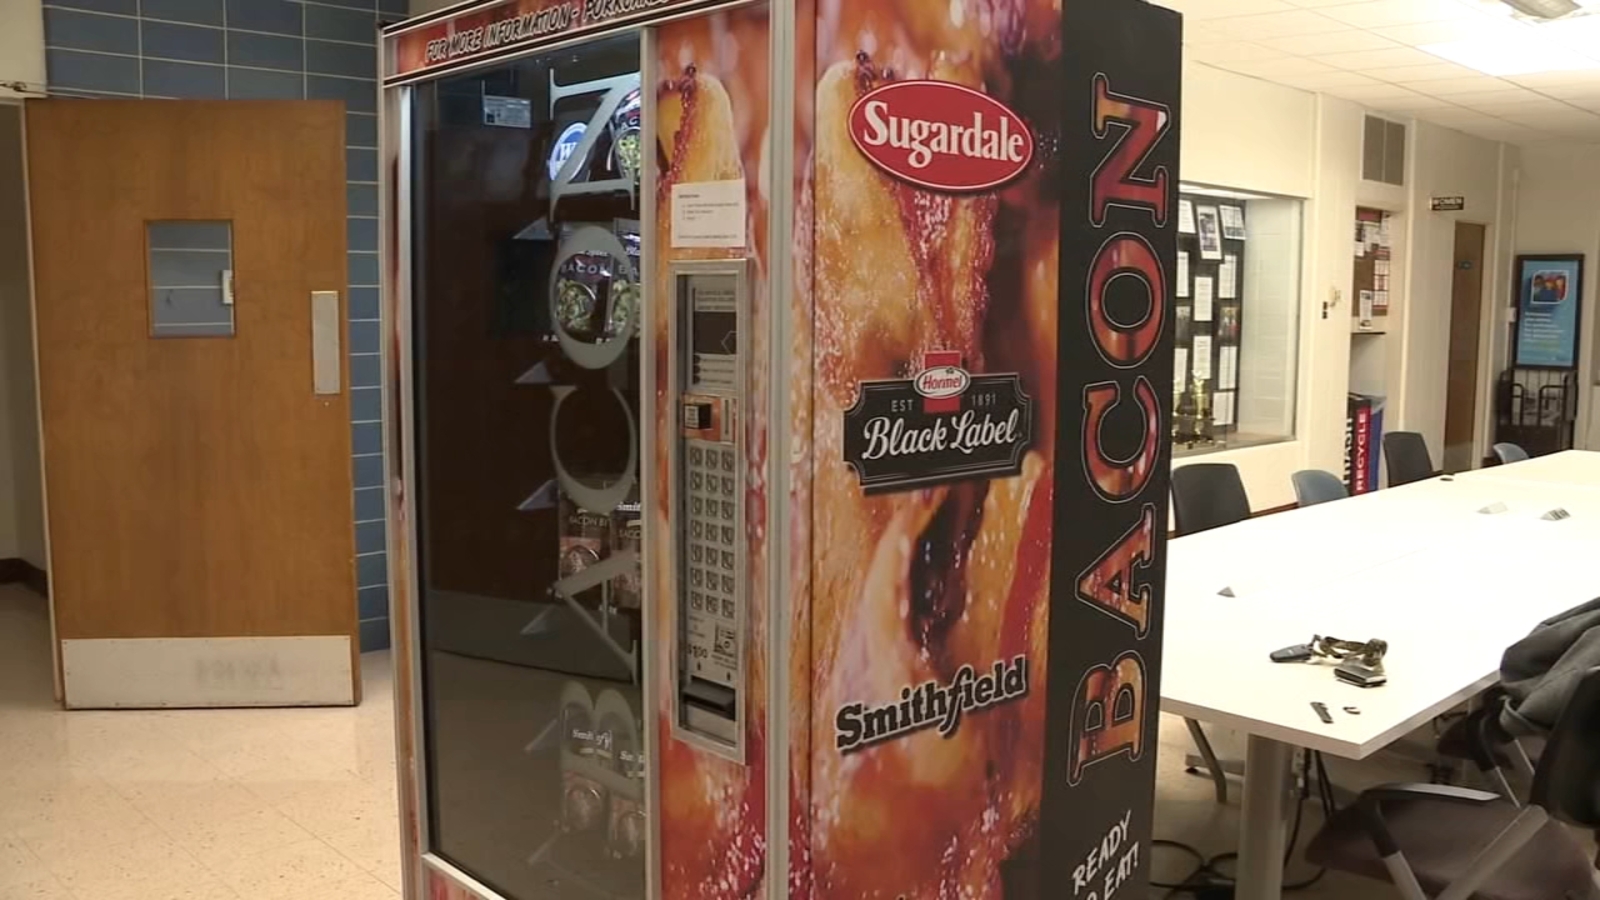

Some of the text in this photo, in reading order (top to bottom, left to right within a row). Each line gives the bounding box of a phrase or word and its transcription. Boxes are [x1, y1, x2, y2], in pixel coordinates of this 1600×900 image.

[425, 37, 448, 62] FOR
[448, 26, 483, 58] MORE
[483, 4, 571, 48] INFORMATION
[863, 100, 1025, 168] Sugardale
[891, 393, 997, 413] EST 1891
[923, 374, 962, 391] Hormel
[861, 407, 1020, 460] Black Label
[1068, 72, 1170, 786] BACON
[1355, 412, 1366, 492] RECYCLE
[836, 655, 1029, 752] Smithfield
[1072, 808, 1132, 896] READY
[1104, 840, 1140, 900] EAT!
